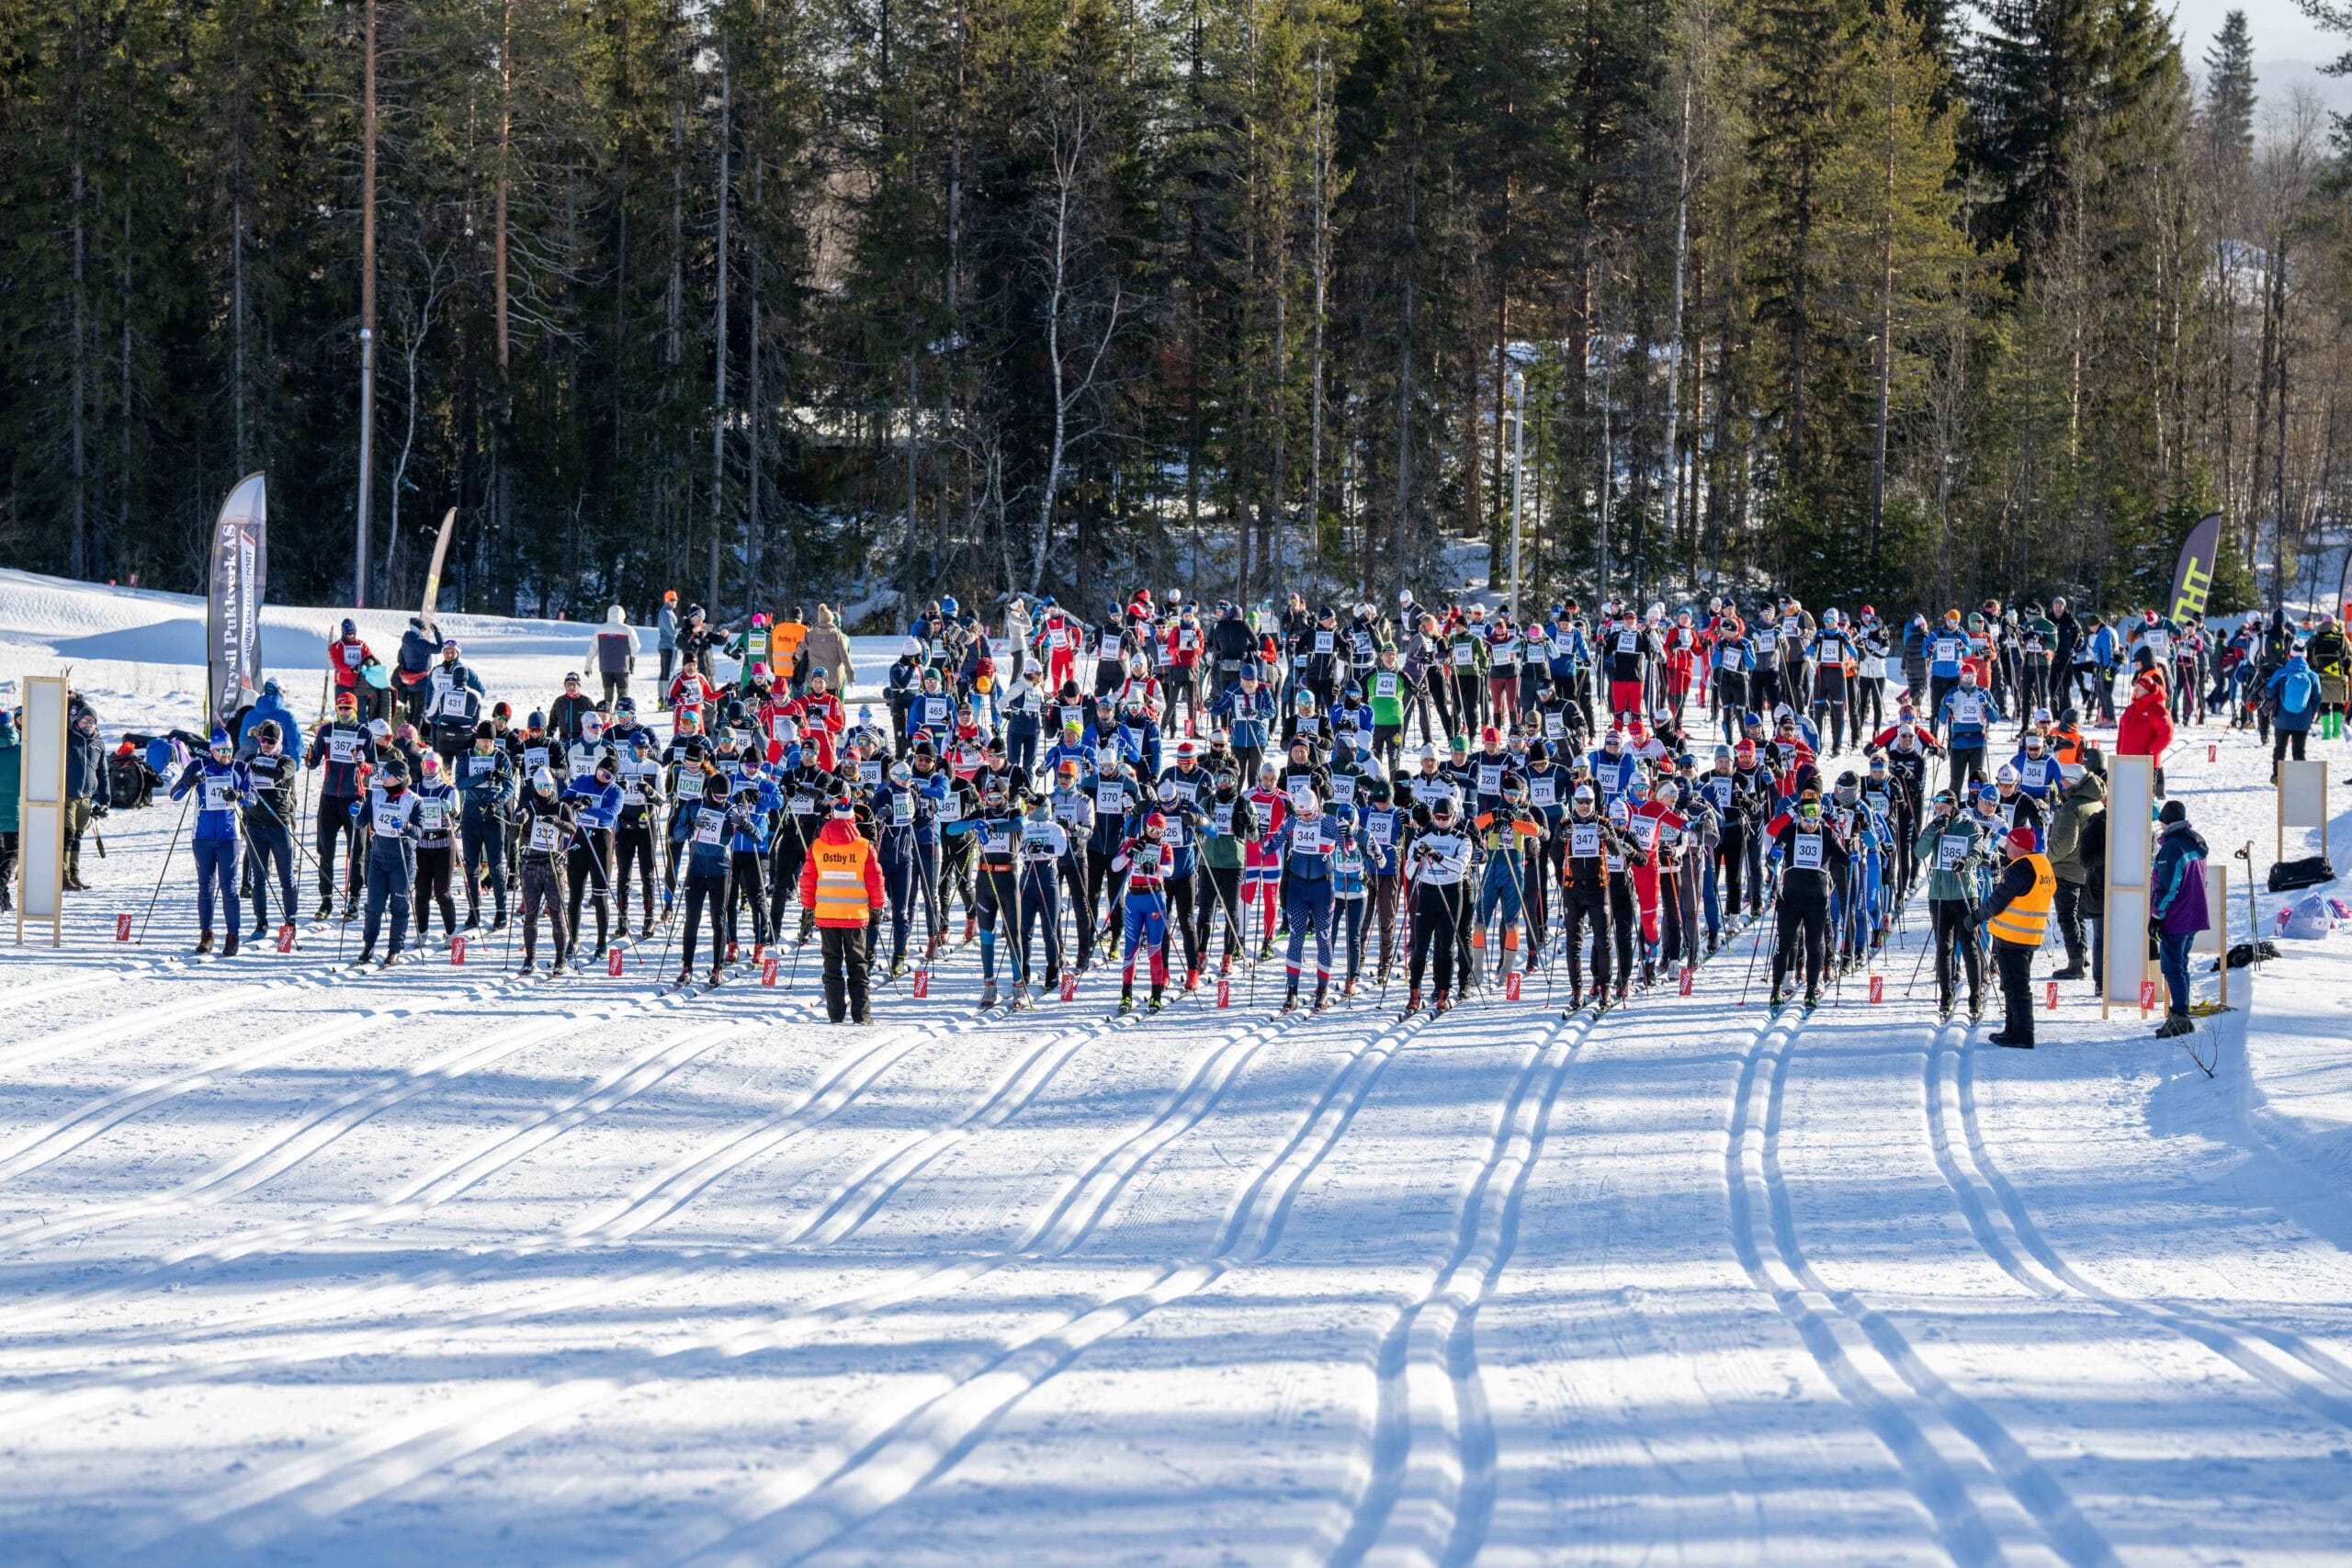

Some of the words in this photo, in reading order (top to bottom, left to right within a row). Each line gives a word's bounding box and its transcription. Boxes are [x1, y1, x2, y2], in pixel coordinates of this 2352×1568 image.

[223, 524, 236, 549] AS
[224, 553, 237, 645] Pukkverk
[1725, 654, 1736, 663] 517
[224, 649, 239, 704] Trysil
[335, 741, 351, 751] 367
[576, 765, 590, 773] 361
[2027, 768, 2041, 777] 304
[861, 771, 876, 779] 388
[1600, 774, 1615, 783] 307
[1482, 776, 1496, 784] 320
[680, 779, 699, 792] 1047
[1291, 785, 1302, 794] 37
[1335, 785, 1350, 793] 390
[211, 788, 222, 797] 47
[1535, 788, 1549, 797] 371
[1102, 793, 1117, 802] 370
[379, 814, 390, 824] 42
[705, 823, 717, 831] 56
[1370, 823, 1387, 832] 339
[1634, 826, 1650, 837] 306
[1661, 826, 1677, 837] 053
[1298, 831, 1315, 841] 344
[1576, 835, 1593, 844] 347
[1799, 845, 1817, 856] 303
[1943, 847, 1961, 858] 385
[823, 852, 847, 864] Østby
[850, 854, 857, 863] IL
